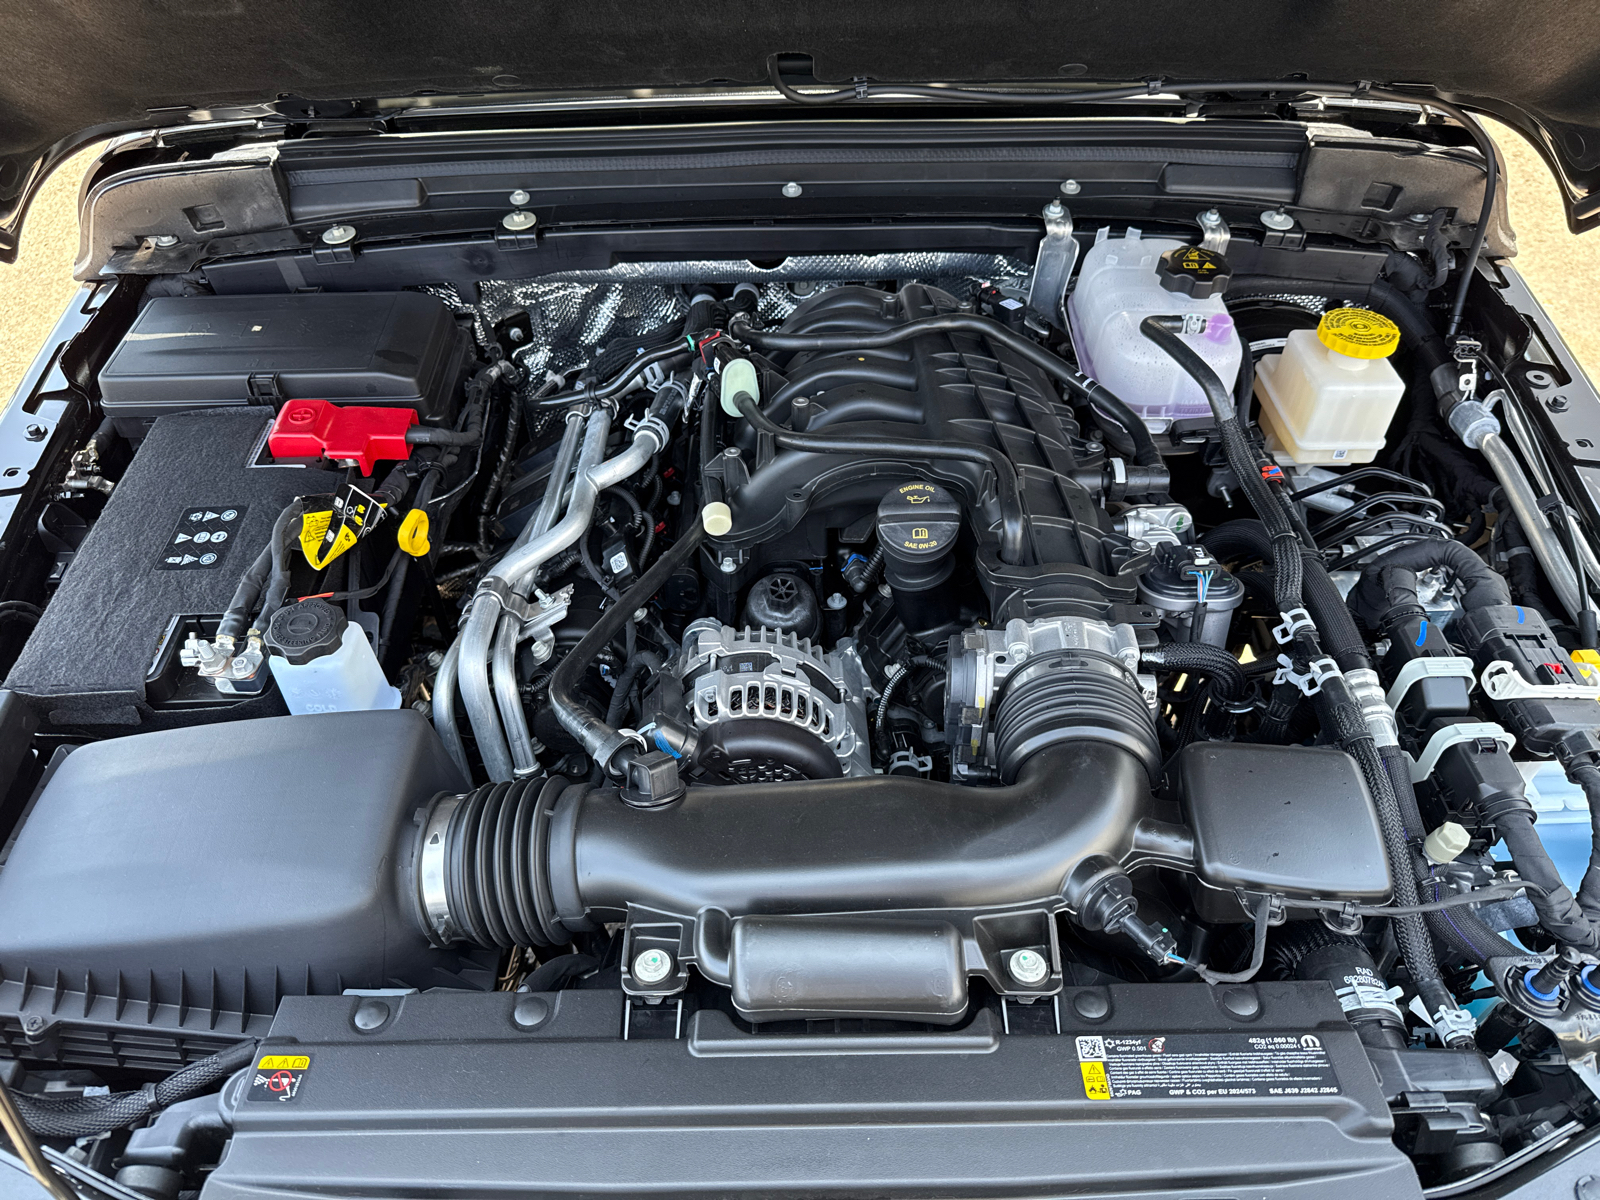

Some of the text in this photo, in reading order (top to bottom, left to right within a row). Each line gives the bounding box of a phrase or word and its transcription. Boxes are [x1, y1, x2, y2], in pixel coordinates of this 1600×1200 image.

[899, 484, 935, 494] ENGINE OIL
[904, 540, 938, 549] SAE 0W-20
[1355, 966, 1374, 977] RAD
